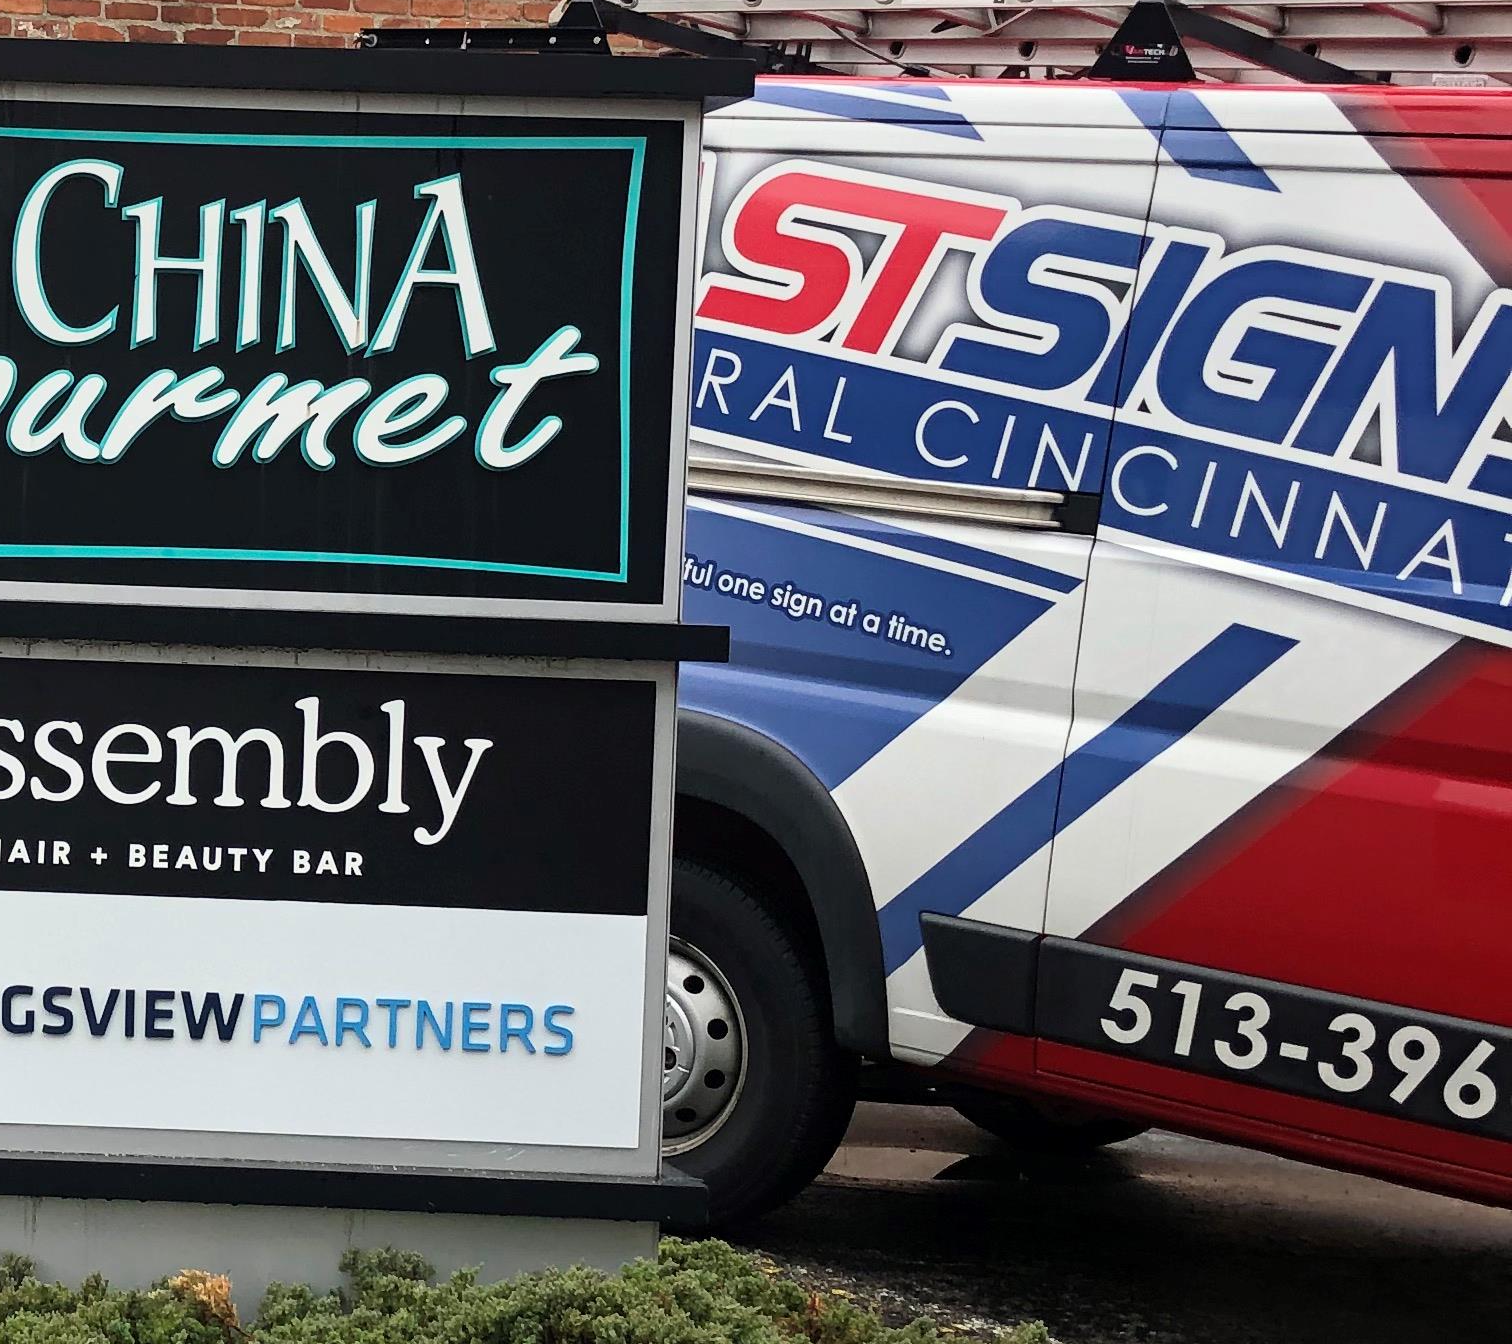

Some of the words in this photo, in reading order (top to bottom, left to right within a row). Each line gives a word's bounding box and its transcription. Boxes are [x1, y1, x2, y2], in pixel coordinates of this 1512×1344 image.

[12, 156, 497, 359] CHINA
[695, 161, 1512, 498] STSIGN
[695, 347, 852, 443] RAL
[683, 556, 713, 587] ful
[718, 573, 765, 600] one
[771, 585, 823, 617] sign
[829, 603, 858, 627] at
[862, 616, 881, 635] a
[887, 614, 952, 656] time.
[128, 843, 275, 873] BEAUTY
[292, 849, 364, 877] BAR
[1100, 967, 1512, 1120] 513-396
